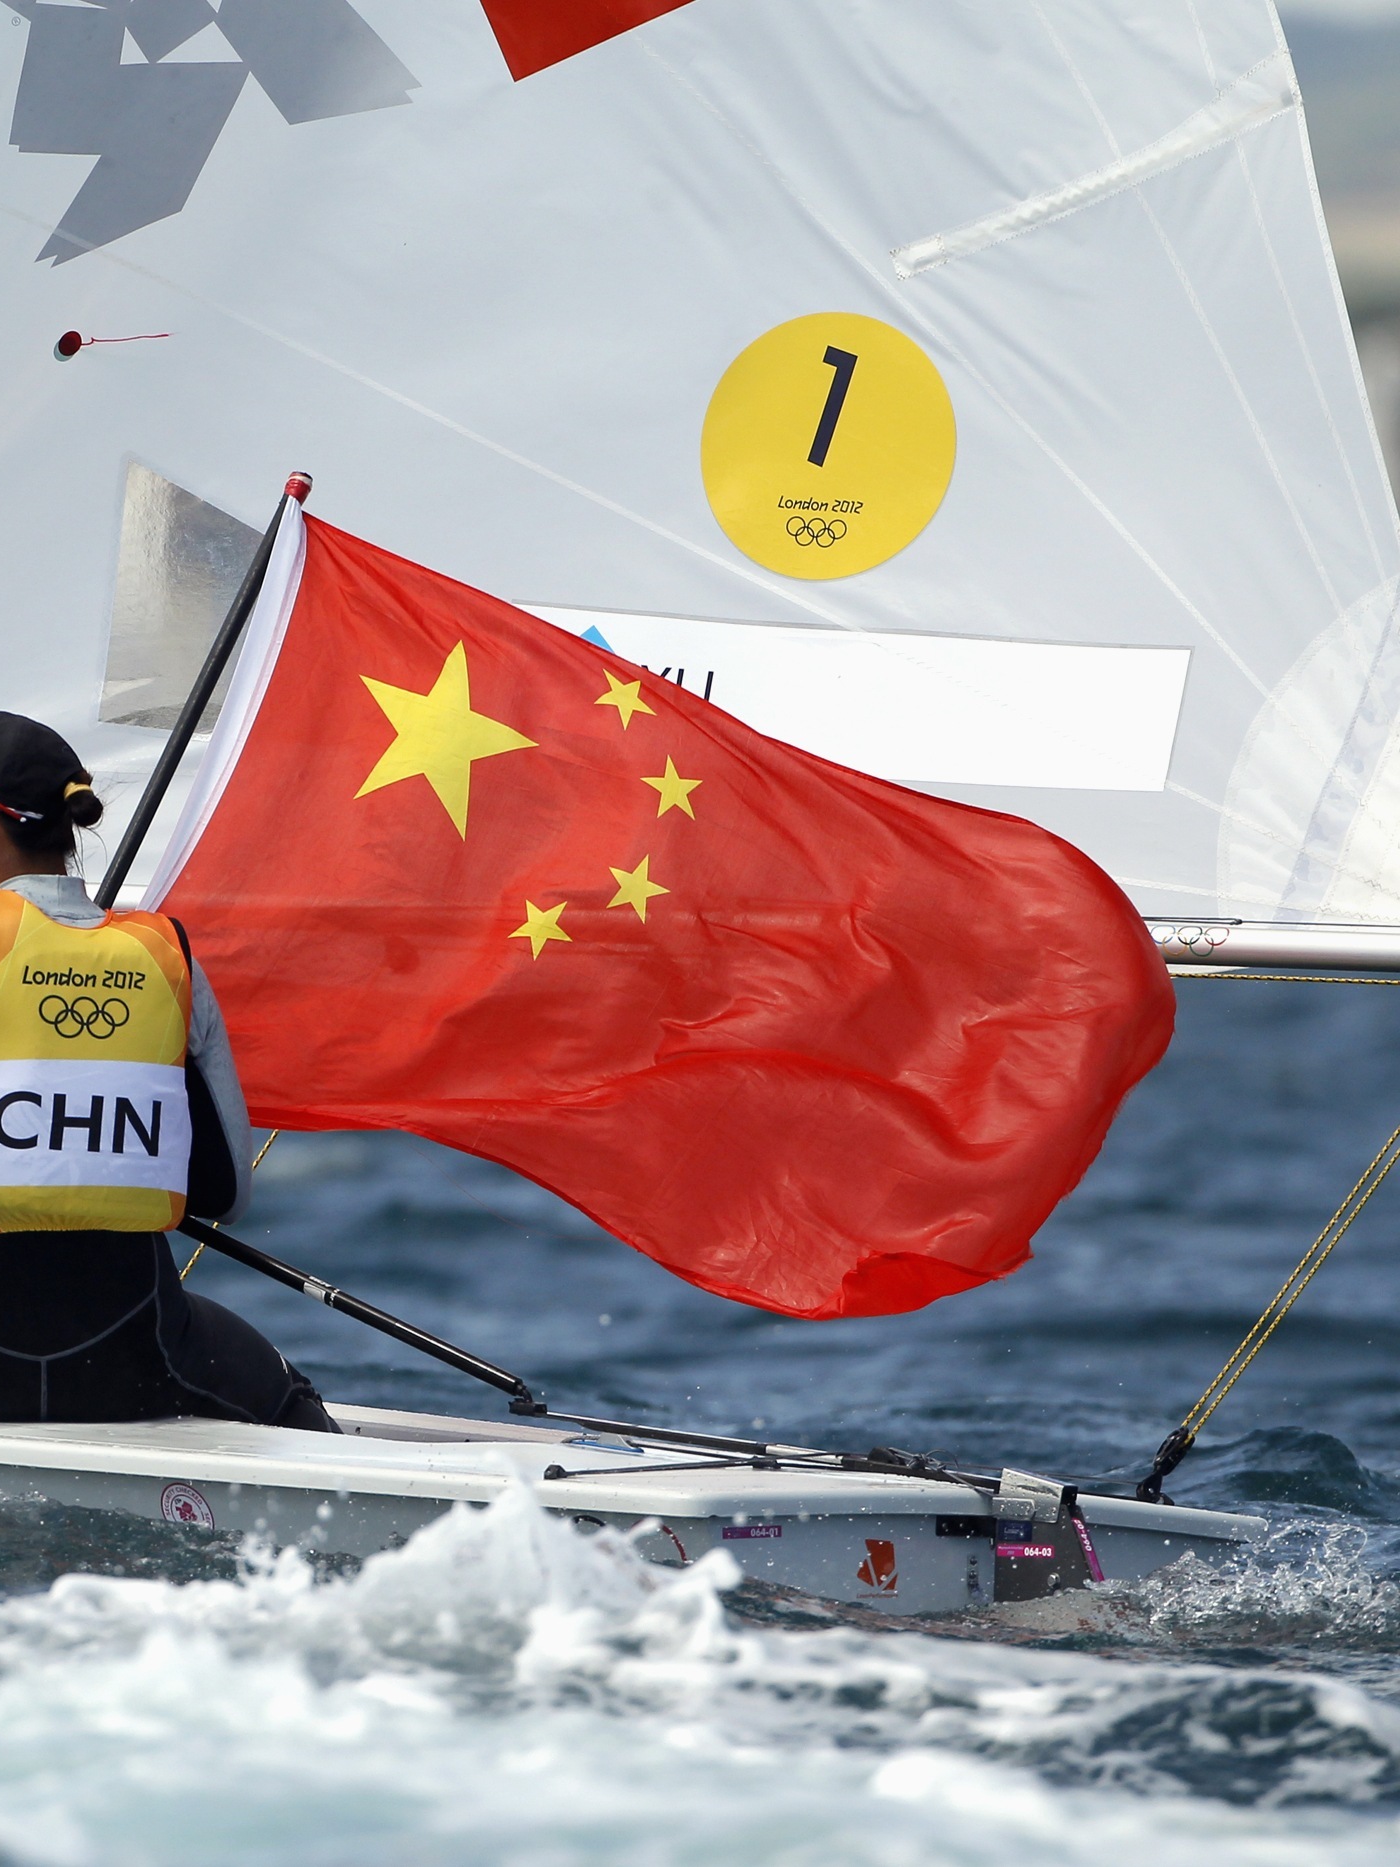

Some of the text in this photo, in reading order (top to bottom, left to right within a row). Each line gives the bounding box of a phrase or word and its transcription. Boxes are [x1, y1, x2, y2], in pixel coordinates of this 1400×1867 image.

[807, 345, 858, 468] 1
[778, 495, 864, 514] London 2012
[22, 965, 146, 990] London 2012
[1024, 1547, 1052, 1556] 064-03
